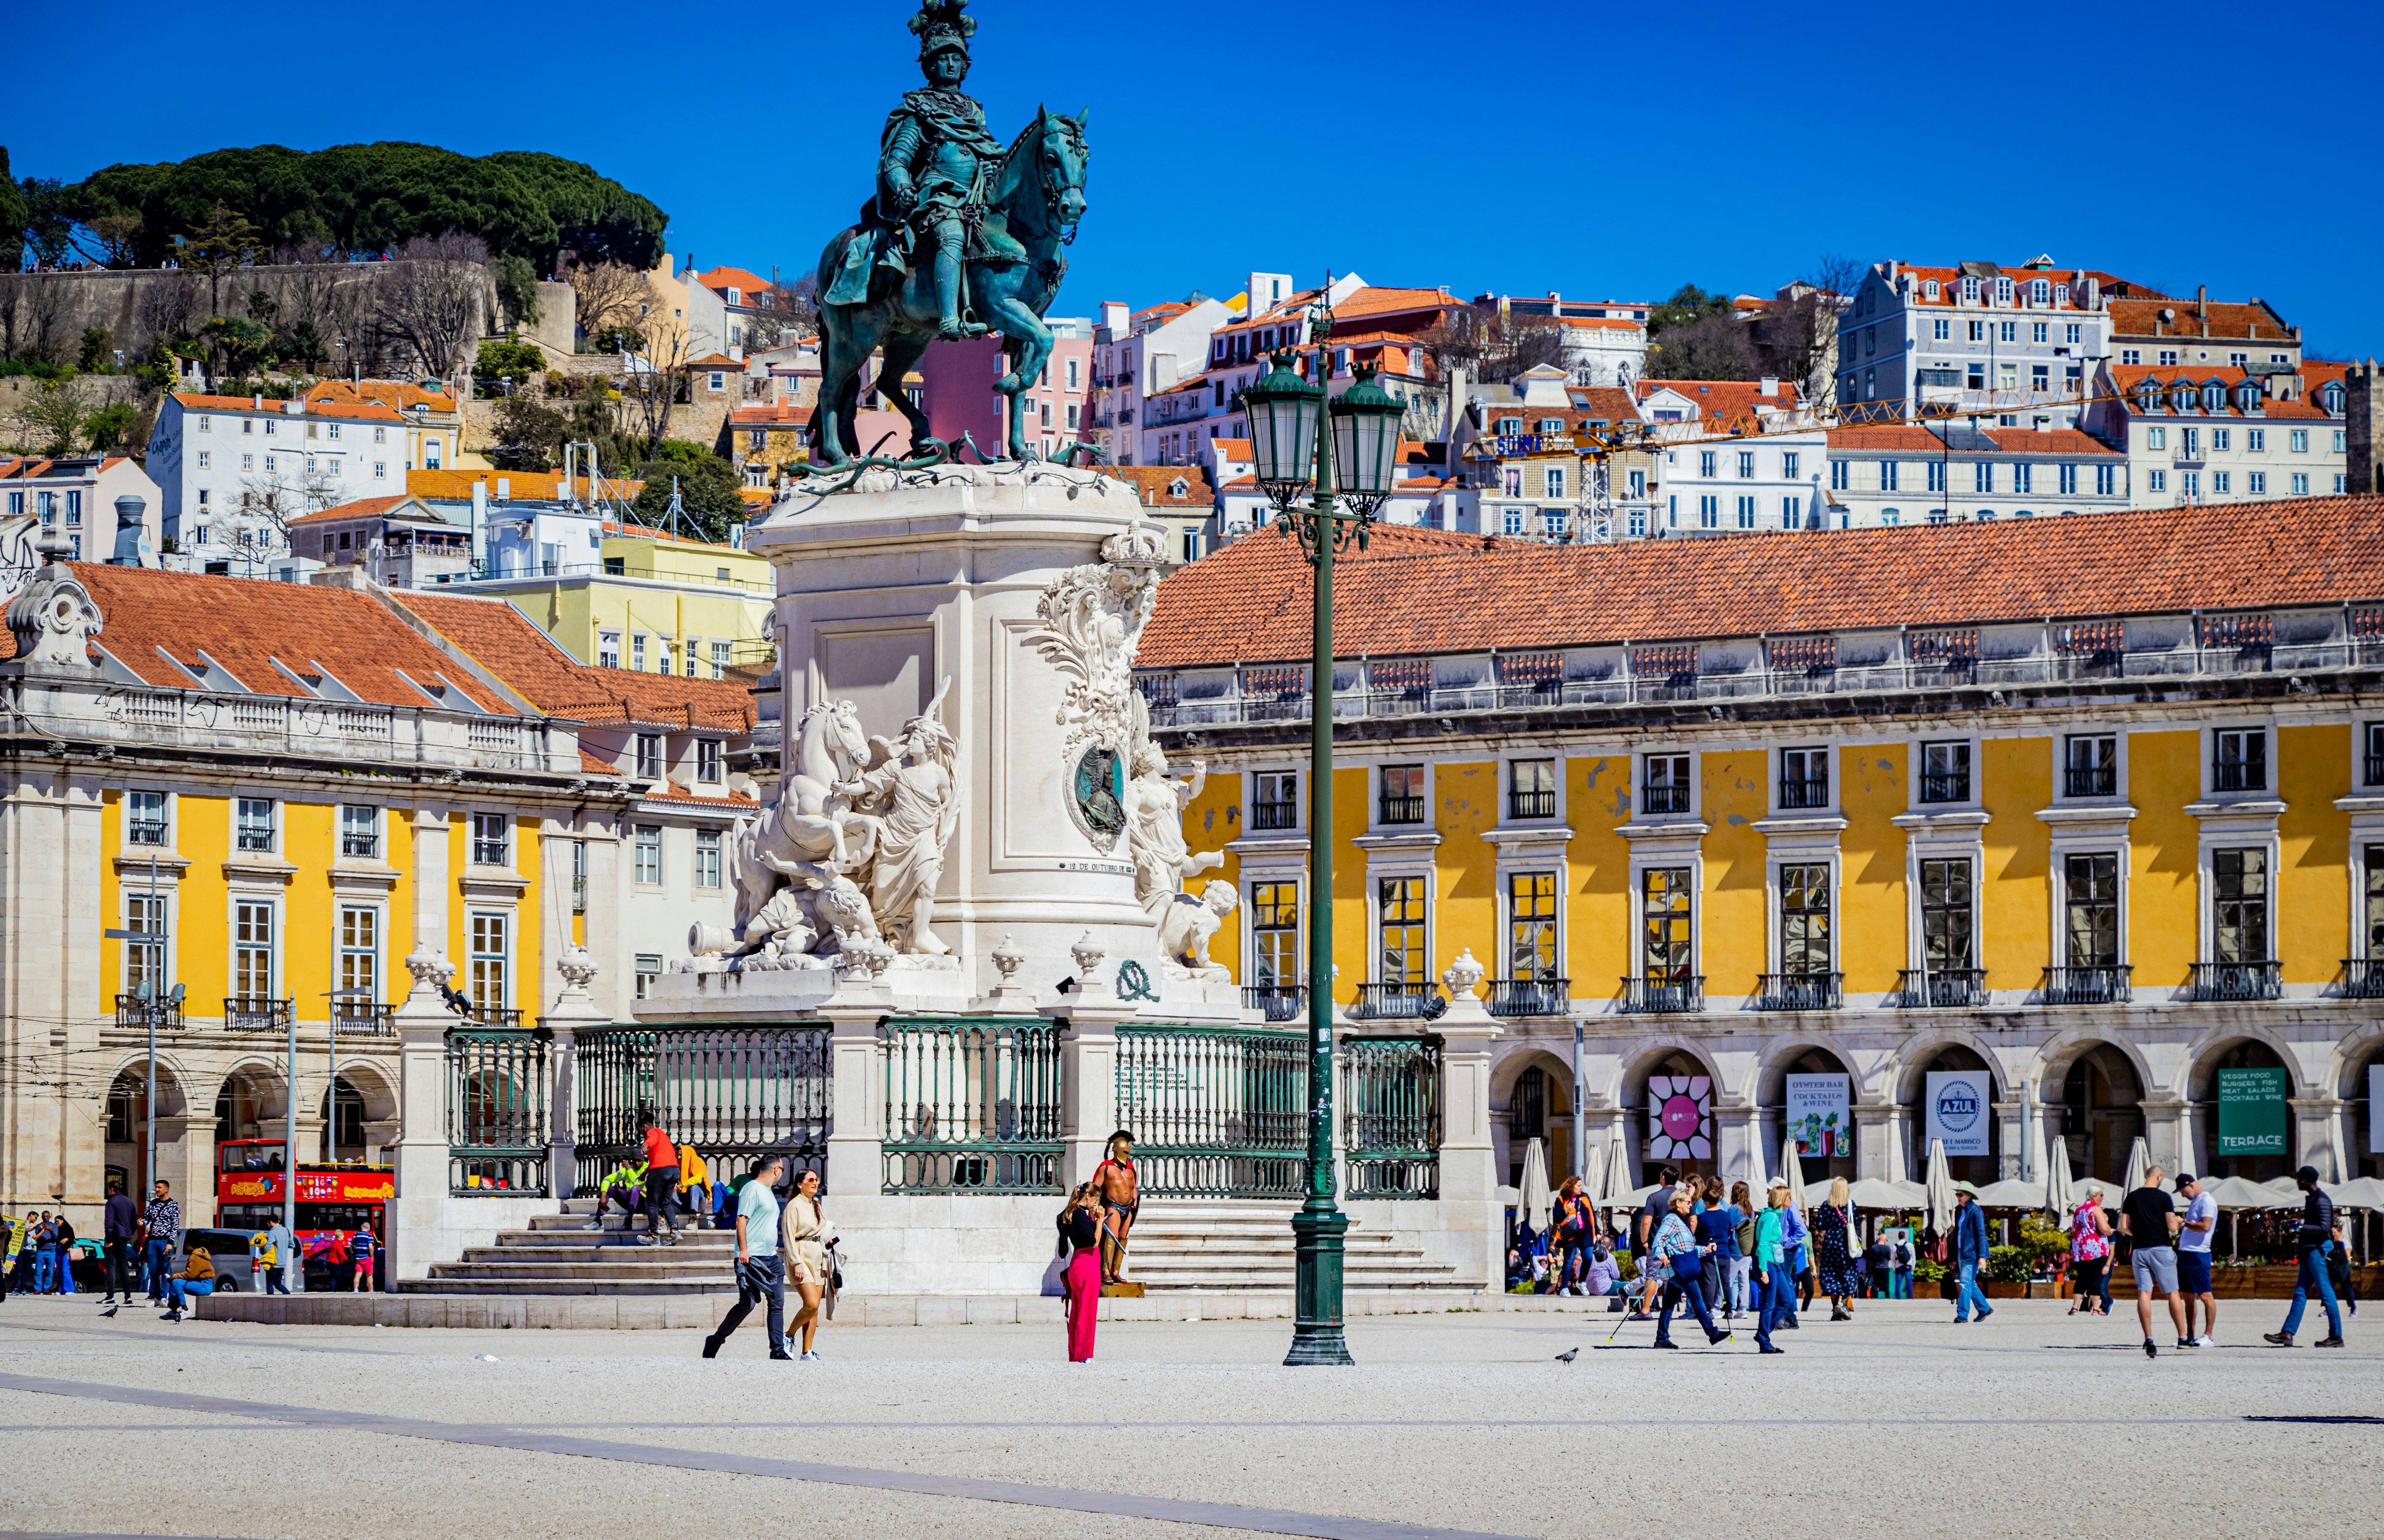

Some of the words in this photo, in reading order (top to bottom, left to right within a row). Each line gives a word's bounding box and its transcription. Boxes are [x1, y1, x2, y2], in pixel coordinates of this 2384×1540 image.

[1497, 434, 1541, 455] SOIMA
[1942, 1101, 1975, 1112] AZUL
[1664, 1113, 1698, 1122] FLORISTA
[2222, 1135, 2282, 1146] TERRACE
[231, 1183, 265, 1197] Portugal
